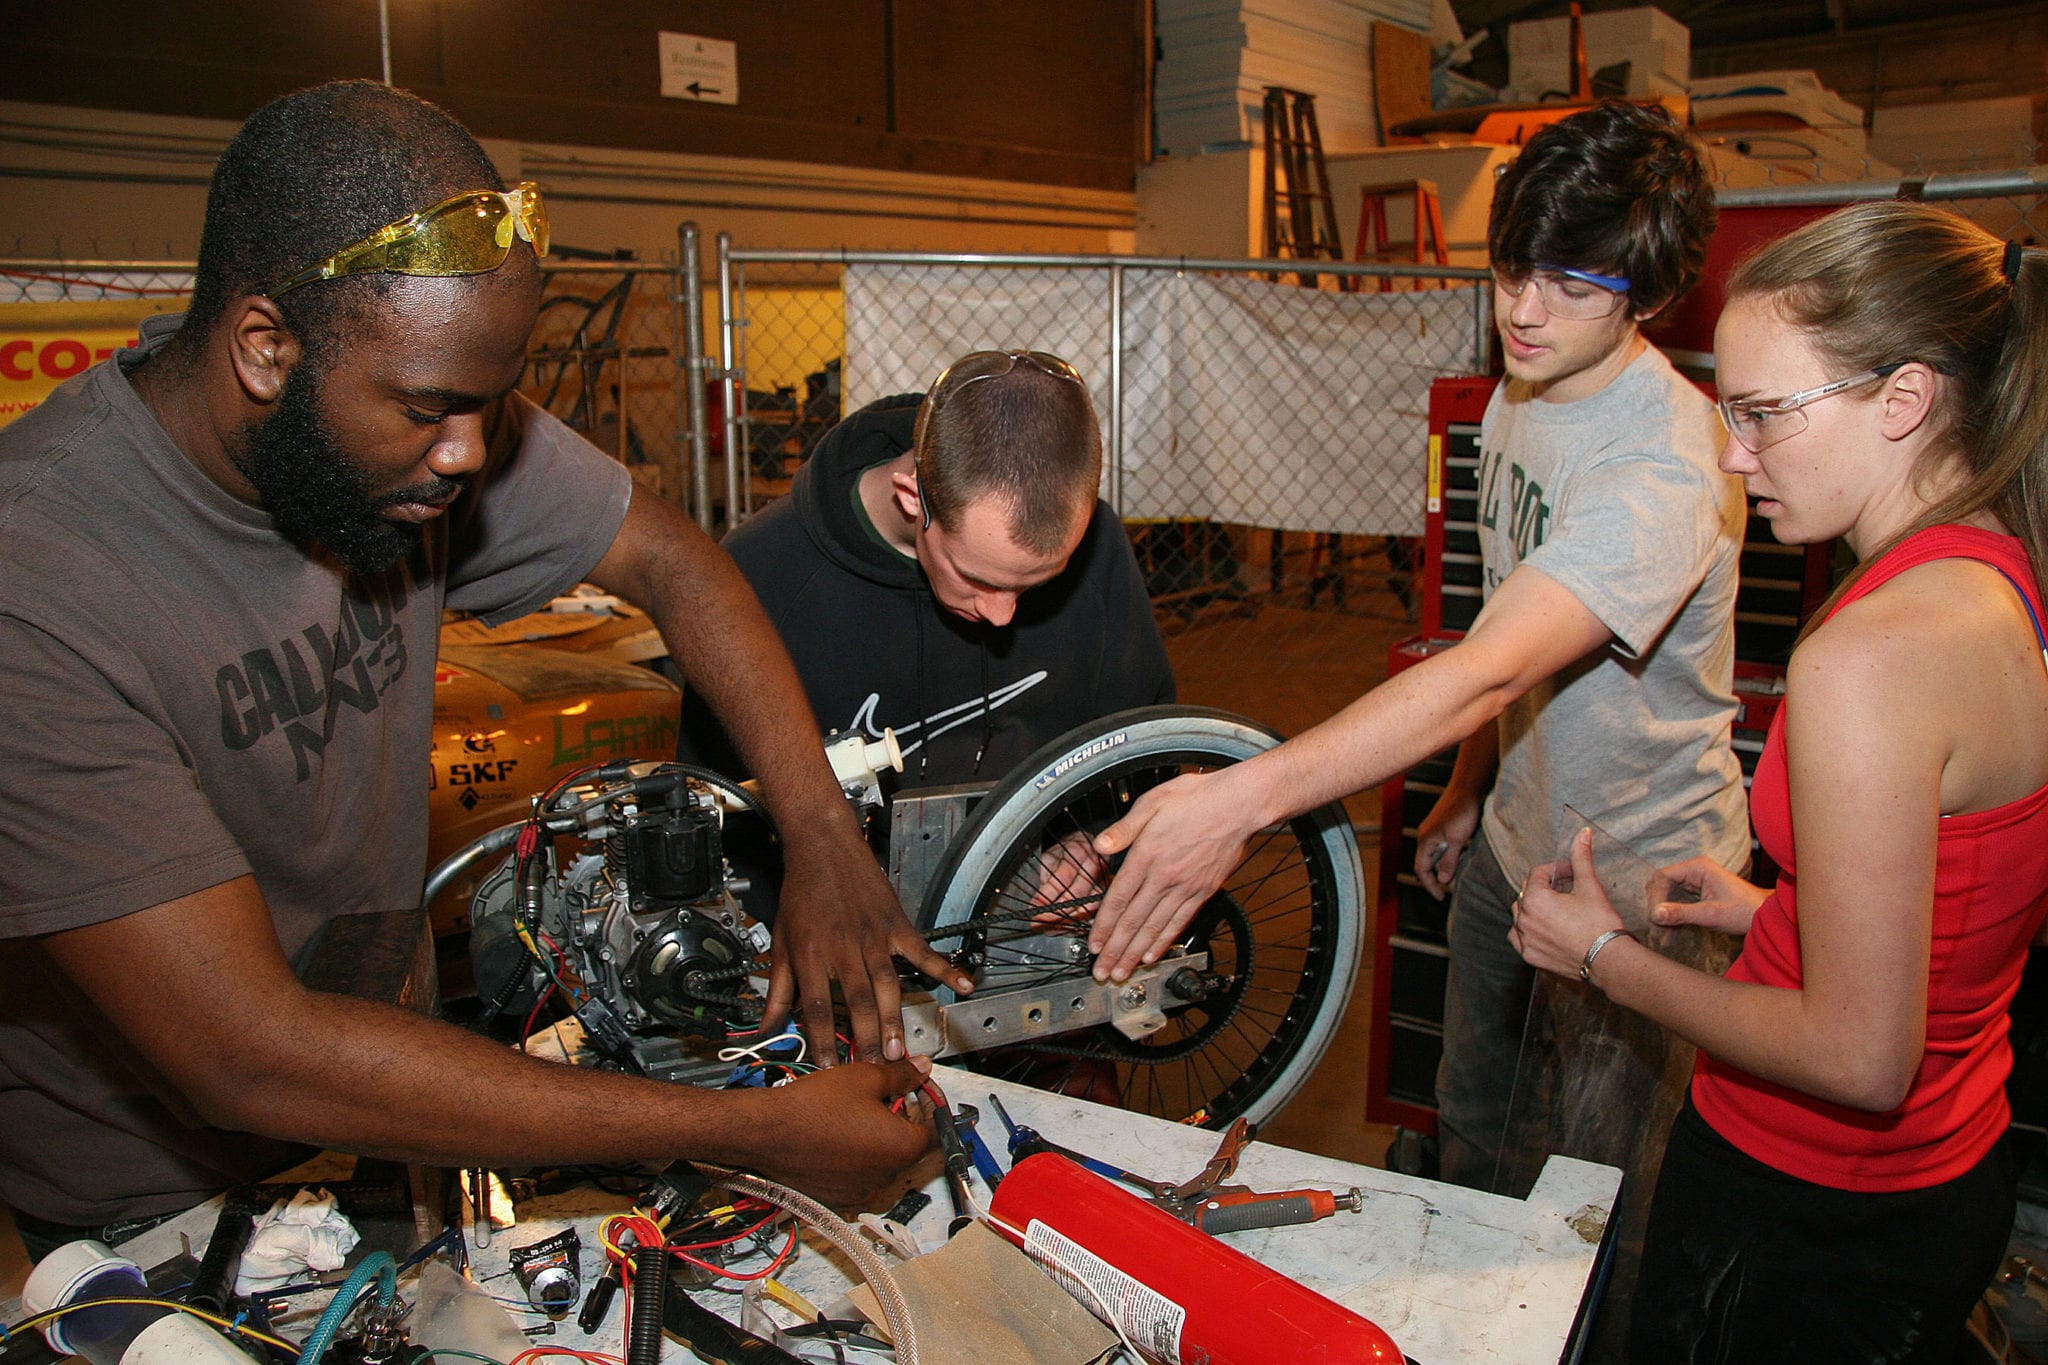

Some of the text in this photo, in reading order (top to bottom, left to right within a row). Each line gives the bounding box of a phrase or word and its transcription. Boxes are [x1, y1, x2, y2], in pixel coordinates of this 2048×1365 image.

[0, 340, 139, 381] CO-
[449, 760, 518, 786] SKF
[1054, 732, 1127, 777] MICHELIN
